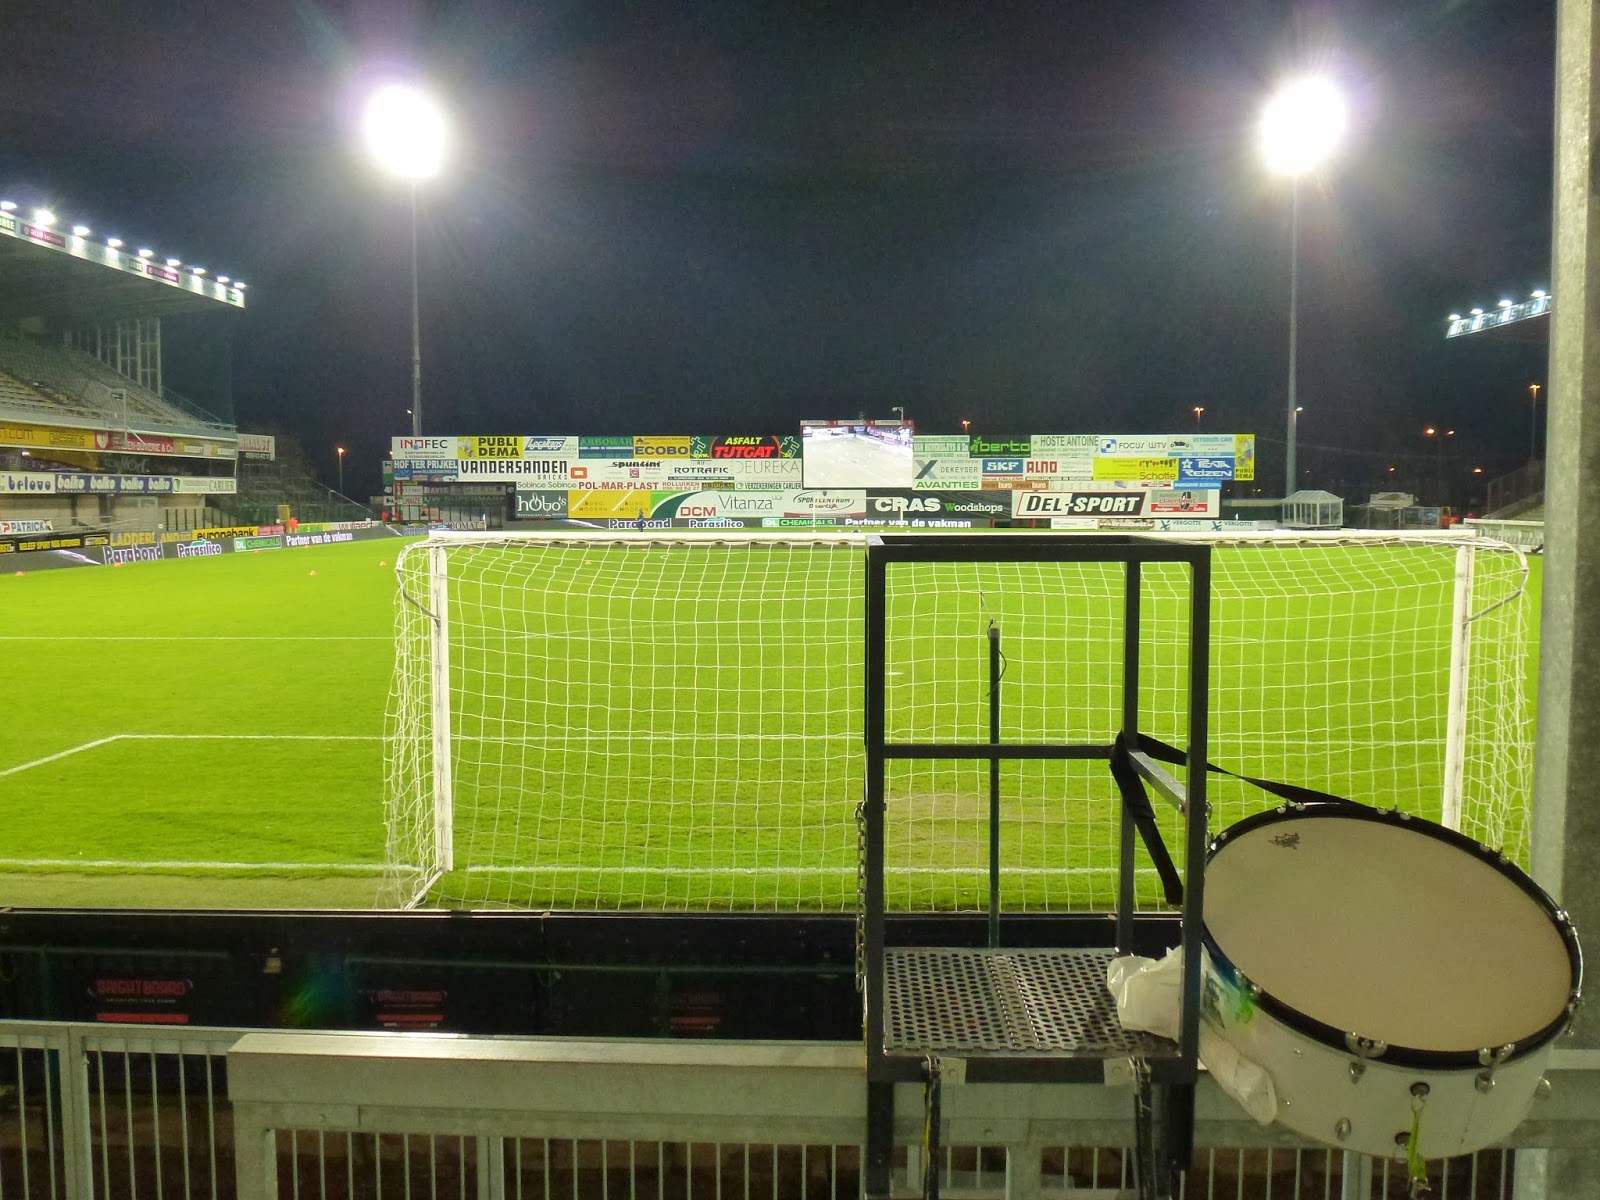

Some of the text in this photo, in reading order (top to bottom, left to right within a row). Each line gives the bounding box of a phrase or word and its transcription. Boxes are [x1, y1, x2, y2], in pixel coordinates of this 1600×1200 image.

[478, 437, 518, 447] PUBLI
[725, 437, 762, 445] ASFALT
[1040, 436, 1099, 447] HOSTE ANTOINE
[478, 447, 520, 457] DEMA
[635, 446, 689, 455] ECOBO
[394, 460, 458, 469] HOF TER PRIJKEL
[461, 460, 568, 474] VANDERSANDEN
[986, 461, 1019, 471] SKF
[1026, 461, 1058, 473] ALNO
[1139, 472, 1176, 480] Schotte
[8, 475, 51, 491] belovo
[578, 481, 659, 490] POL-MAR-PLAST
[718, 494, 773, 510] Vitanza
[875, 498, 1003, 514] CRAS Woodshops
[1025, 495, 1140, 512] DEL-SPORT
[680, 506, 717, 517] DCM
[11, 522, 44, 532] PATRICK
[688, 519, 745, 528] Parasilico
[845, 518, 886, 527] Partner
[911, 518, 926, 528] de
[928, 519, 972, 528] vakman
[197, 528, 254, 540] europabank
[247, 538, 280, 549] CHEMICALS
[286, 535, 310, 547] Partner
[311, 536, 323, 545] van
[323, 533, 331, 543] de
[103, 542, 165, 565] Parabond
[177, 541, 222, 558] Parasilico
